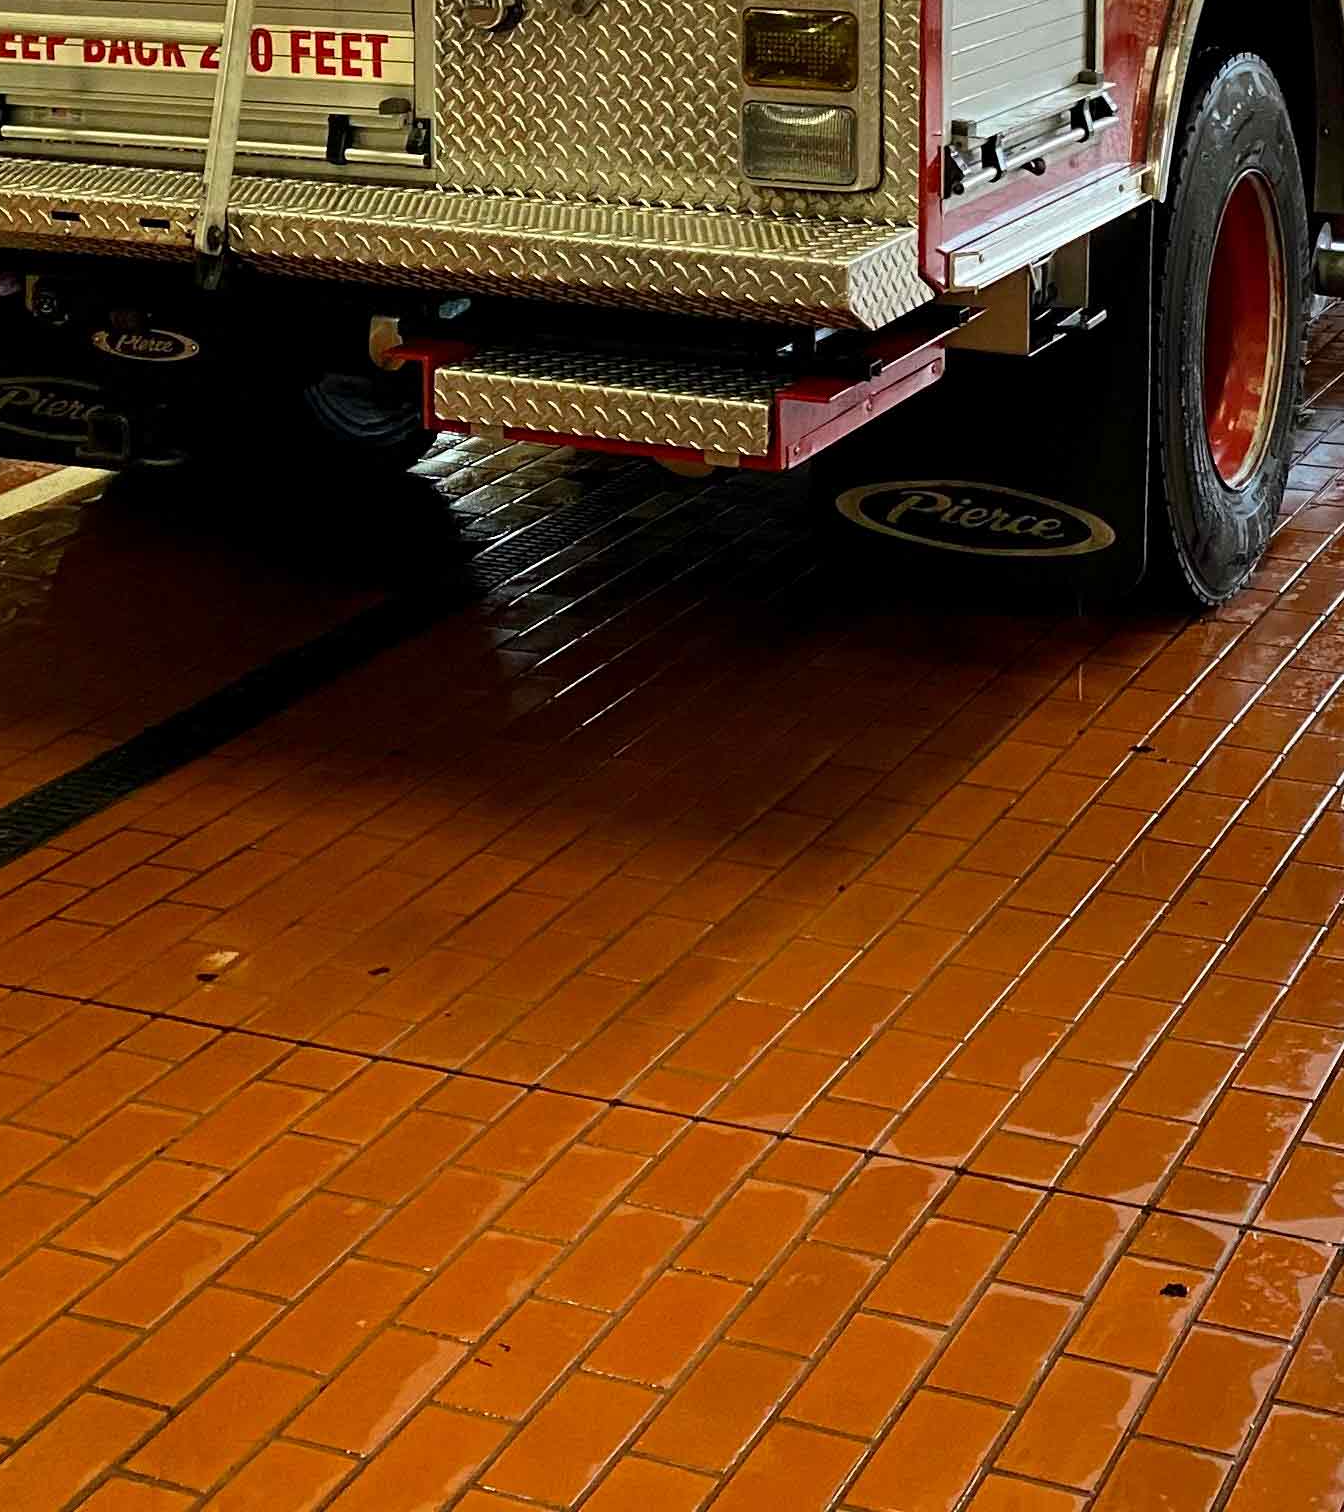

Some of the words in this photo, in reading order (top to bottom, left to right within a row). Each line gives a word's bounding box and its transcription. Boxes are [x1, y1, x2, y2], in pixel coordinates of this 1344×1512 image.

[199, 28, 273, 72] 20
[290, 30, 389, 78] FEET
[115, 334, 174, 353] Pierce
[885, 489, 1065, 539] Pierce
